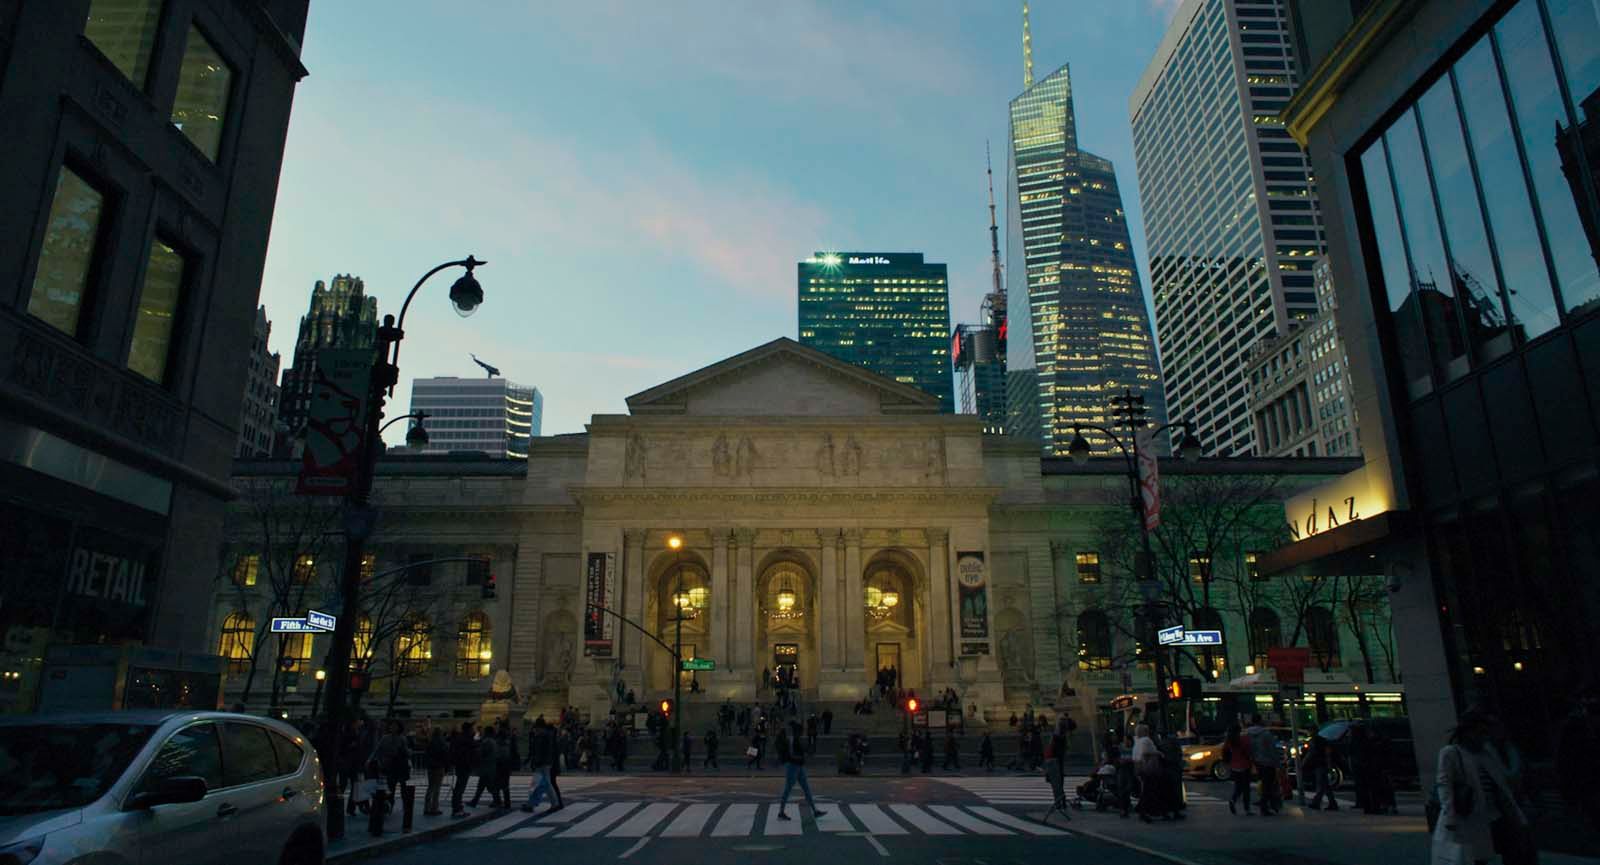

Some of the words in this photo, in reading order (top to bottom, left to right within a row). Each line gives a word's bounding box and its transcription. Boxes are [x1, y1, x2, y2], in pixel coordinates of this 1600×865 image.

[67, 546, 145, 608] RETAIL
[280, 620, 301, 630] Fifth
[1197, 633, 1213, 642] Ave
